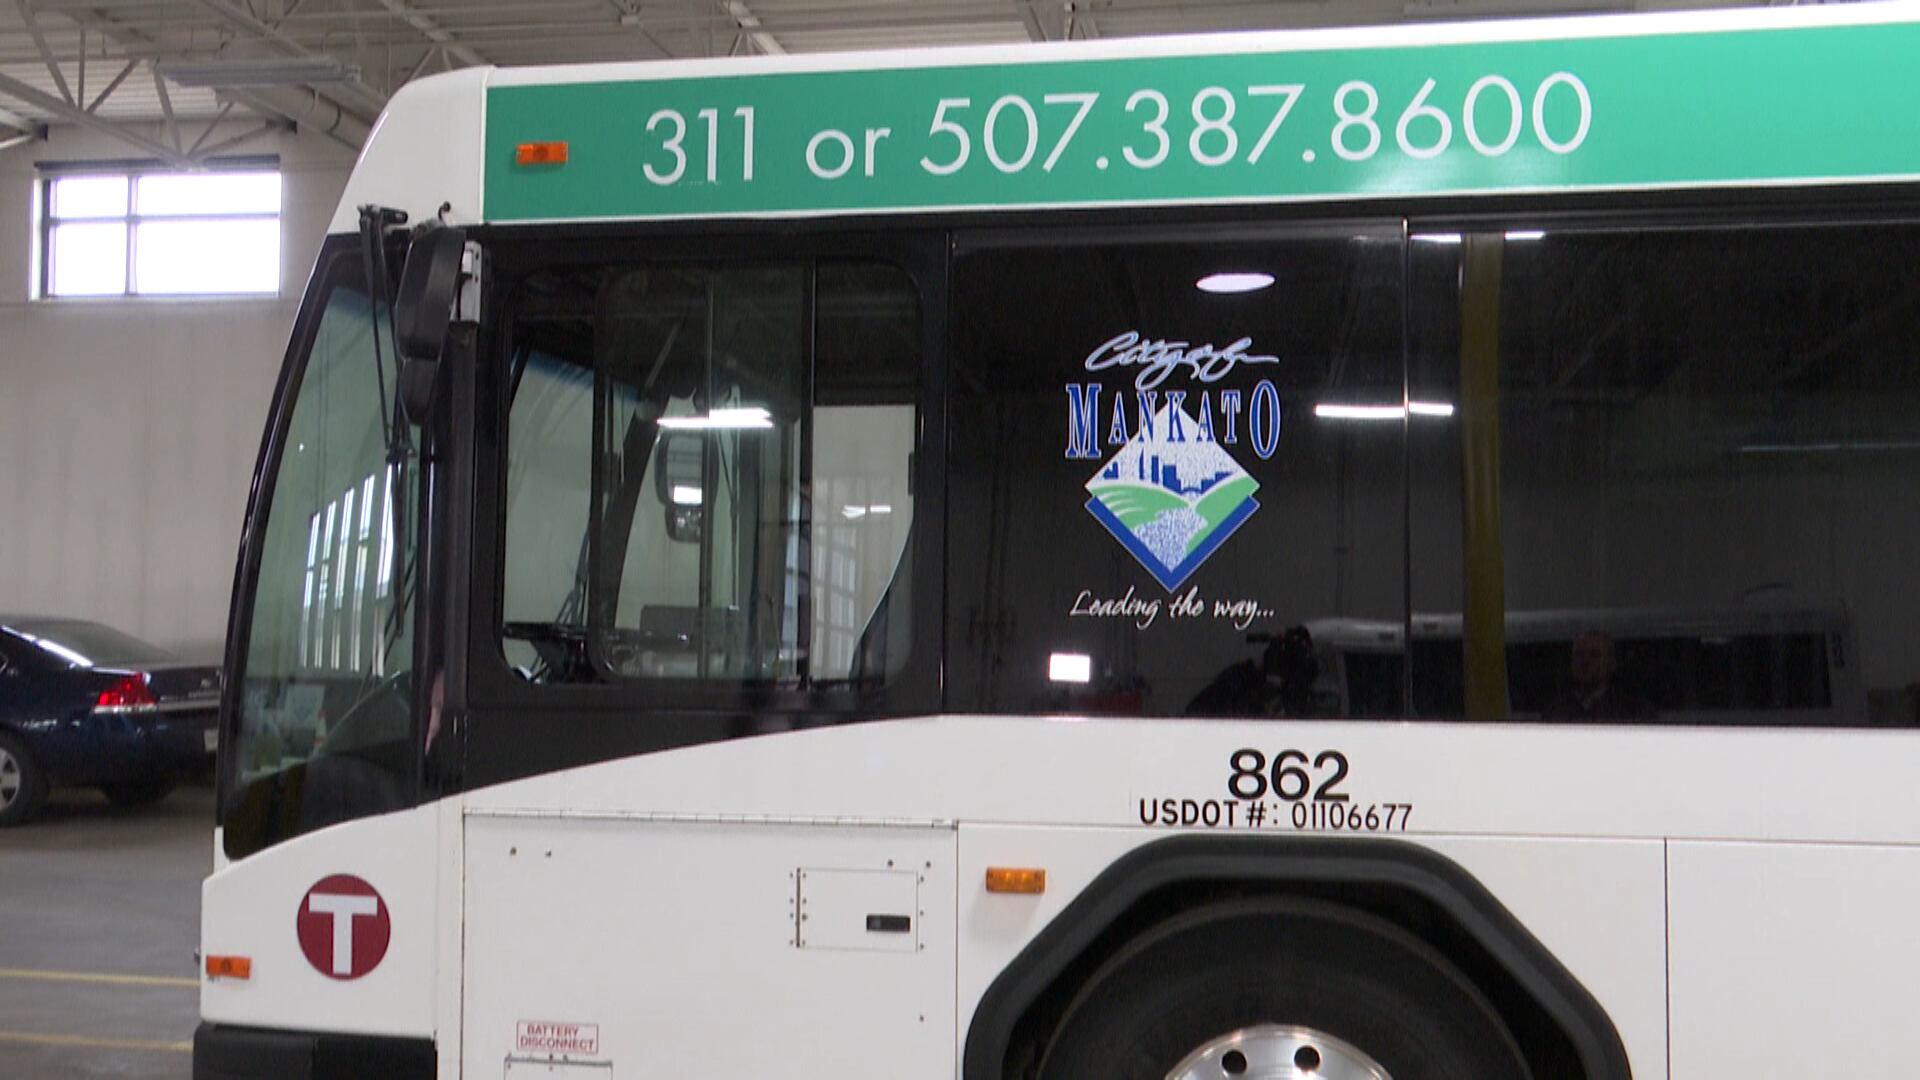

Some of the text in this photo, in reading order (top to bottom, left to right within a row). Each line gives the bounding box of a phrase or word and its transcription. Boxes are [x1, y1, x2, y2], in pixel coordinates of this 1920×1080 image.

[642, 71, 1593, 186] 311 or 507.387.8600
[1084, 330, 1189, 390] City
[1065, 379, 1281, 460] MANKATO
[1069, 585, 1162, 630] Leading
[1168, 586, 1205, 619] the
[1228, 748, 1350, 801] 862
[1139, 798, 1239, 827] USDOT
[1291, 801, 1413, 831] 01106677
[308, 892, 378, 975] T
[520, 1036, 594, 1051] DISCONNECT
[527, 1024, 579, 1037] BATTERY
